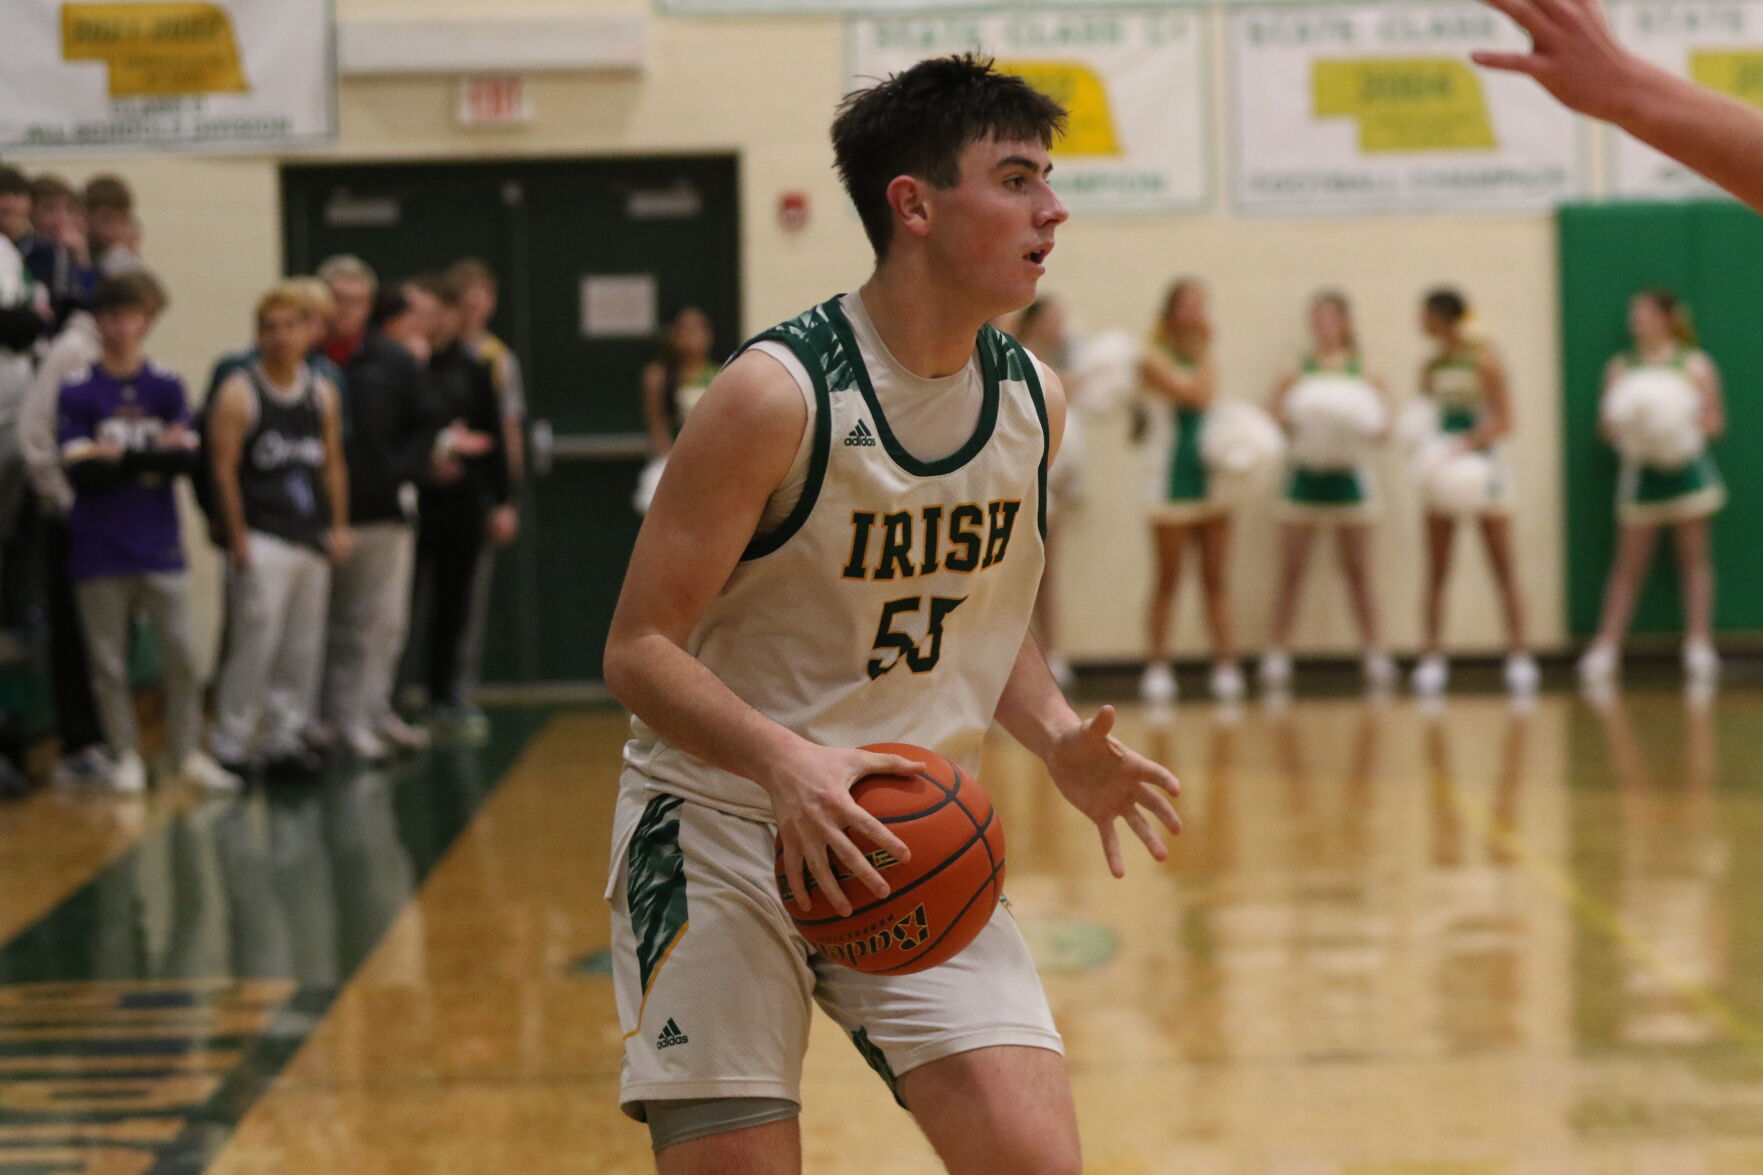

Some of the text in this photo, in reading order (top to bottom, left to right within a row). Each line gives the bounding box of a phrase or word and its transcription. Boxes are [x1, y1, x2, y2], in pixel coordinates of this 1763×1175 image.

[843, 433, 876, 447] adidas
[840, 498, 1022, 582] IRISH
[867, 594, 969, 681] 55
[656, 1034, 689, 1050] adidas
